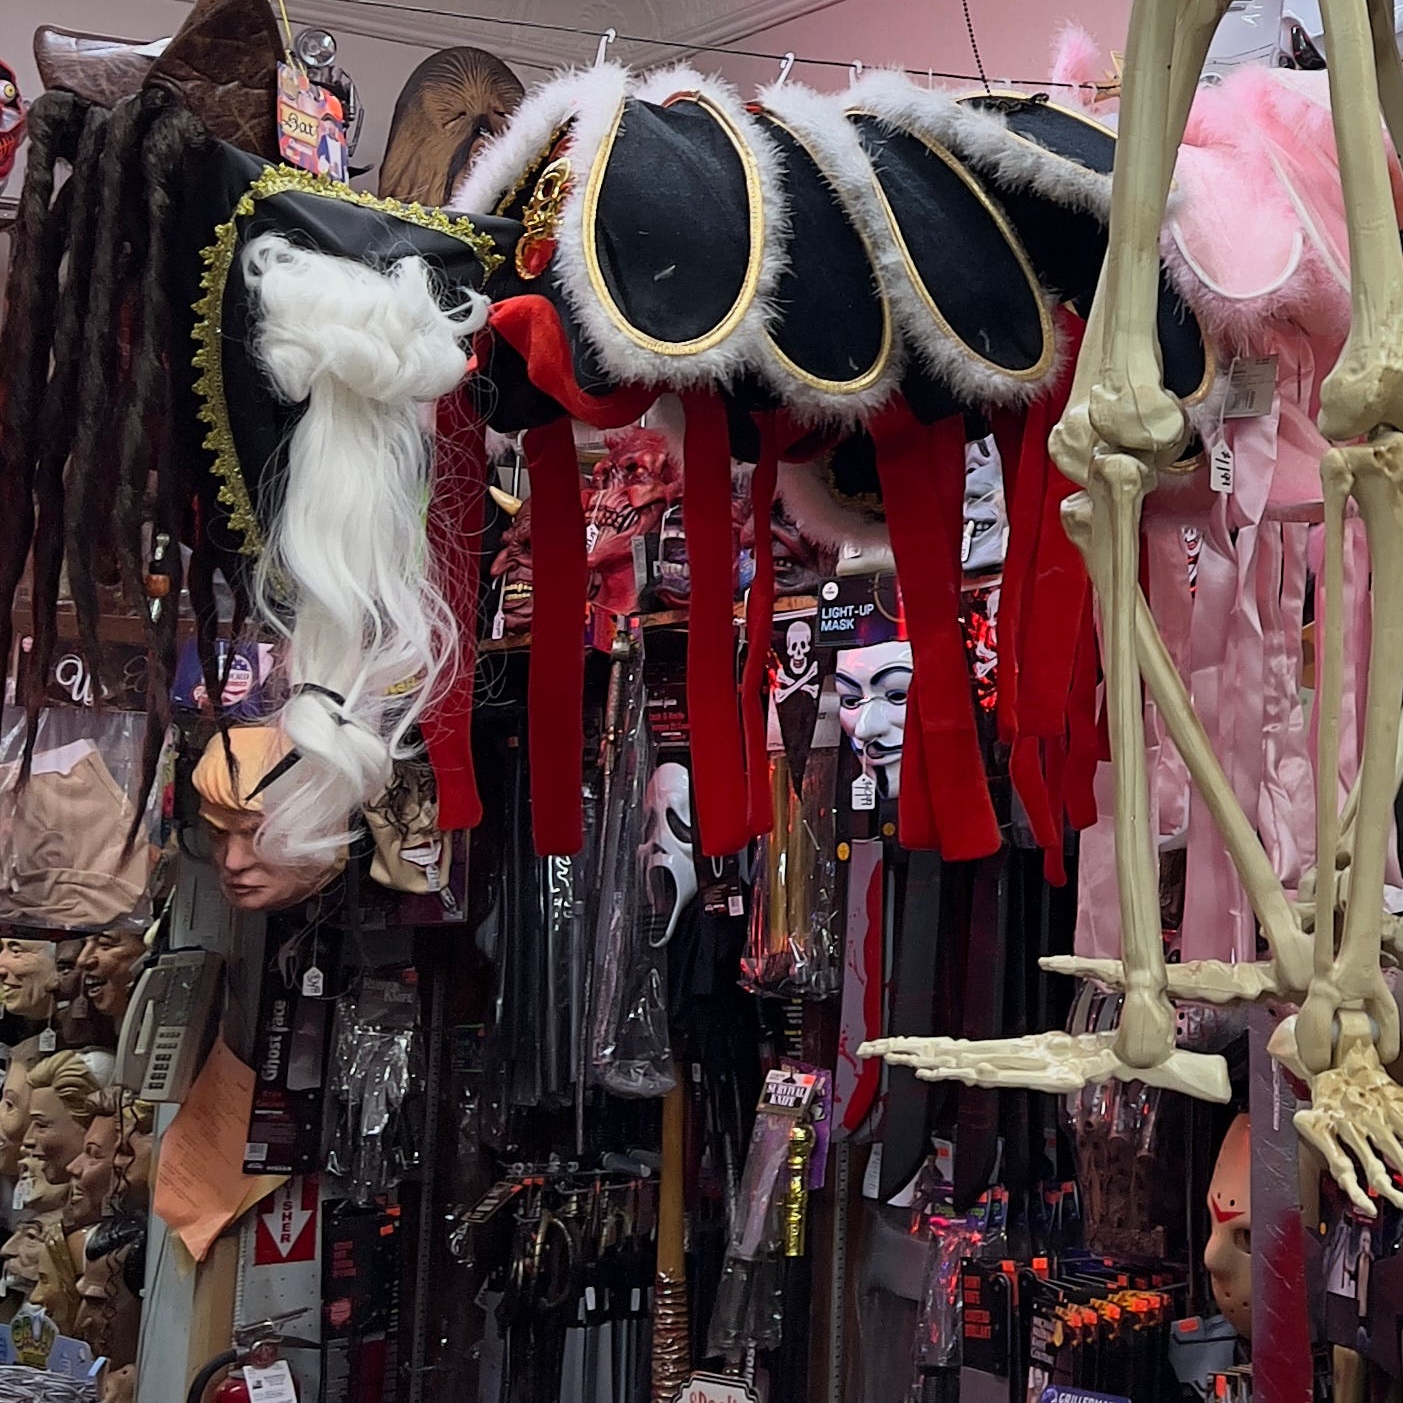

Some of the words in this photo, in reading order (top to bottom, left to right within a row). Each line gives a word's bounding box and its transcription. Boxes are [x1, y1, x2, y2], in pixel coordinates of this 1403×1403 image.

[821, 603, 875, 619] LIGHT-UP
[820, 618, 855, 632] MASK
[261, 1034, 282, 1082] Ghost
